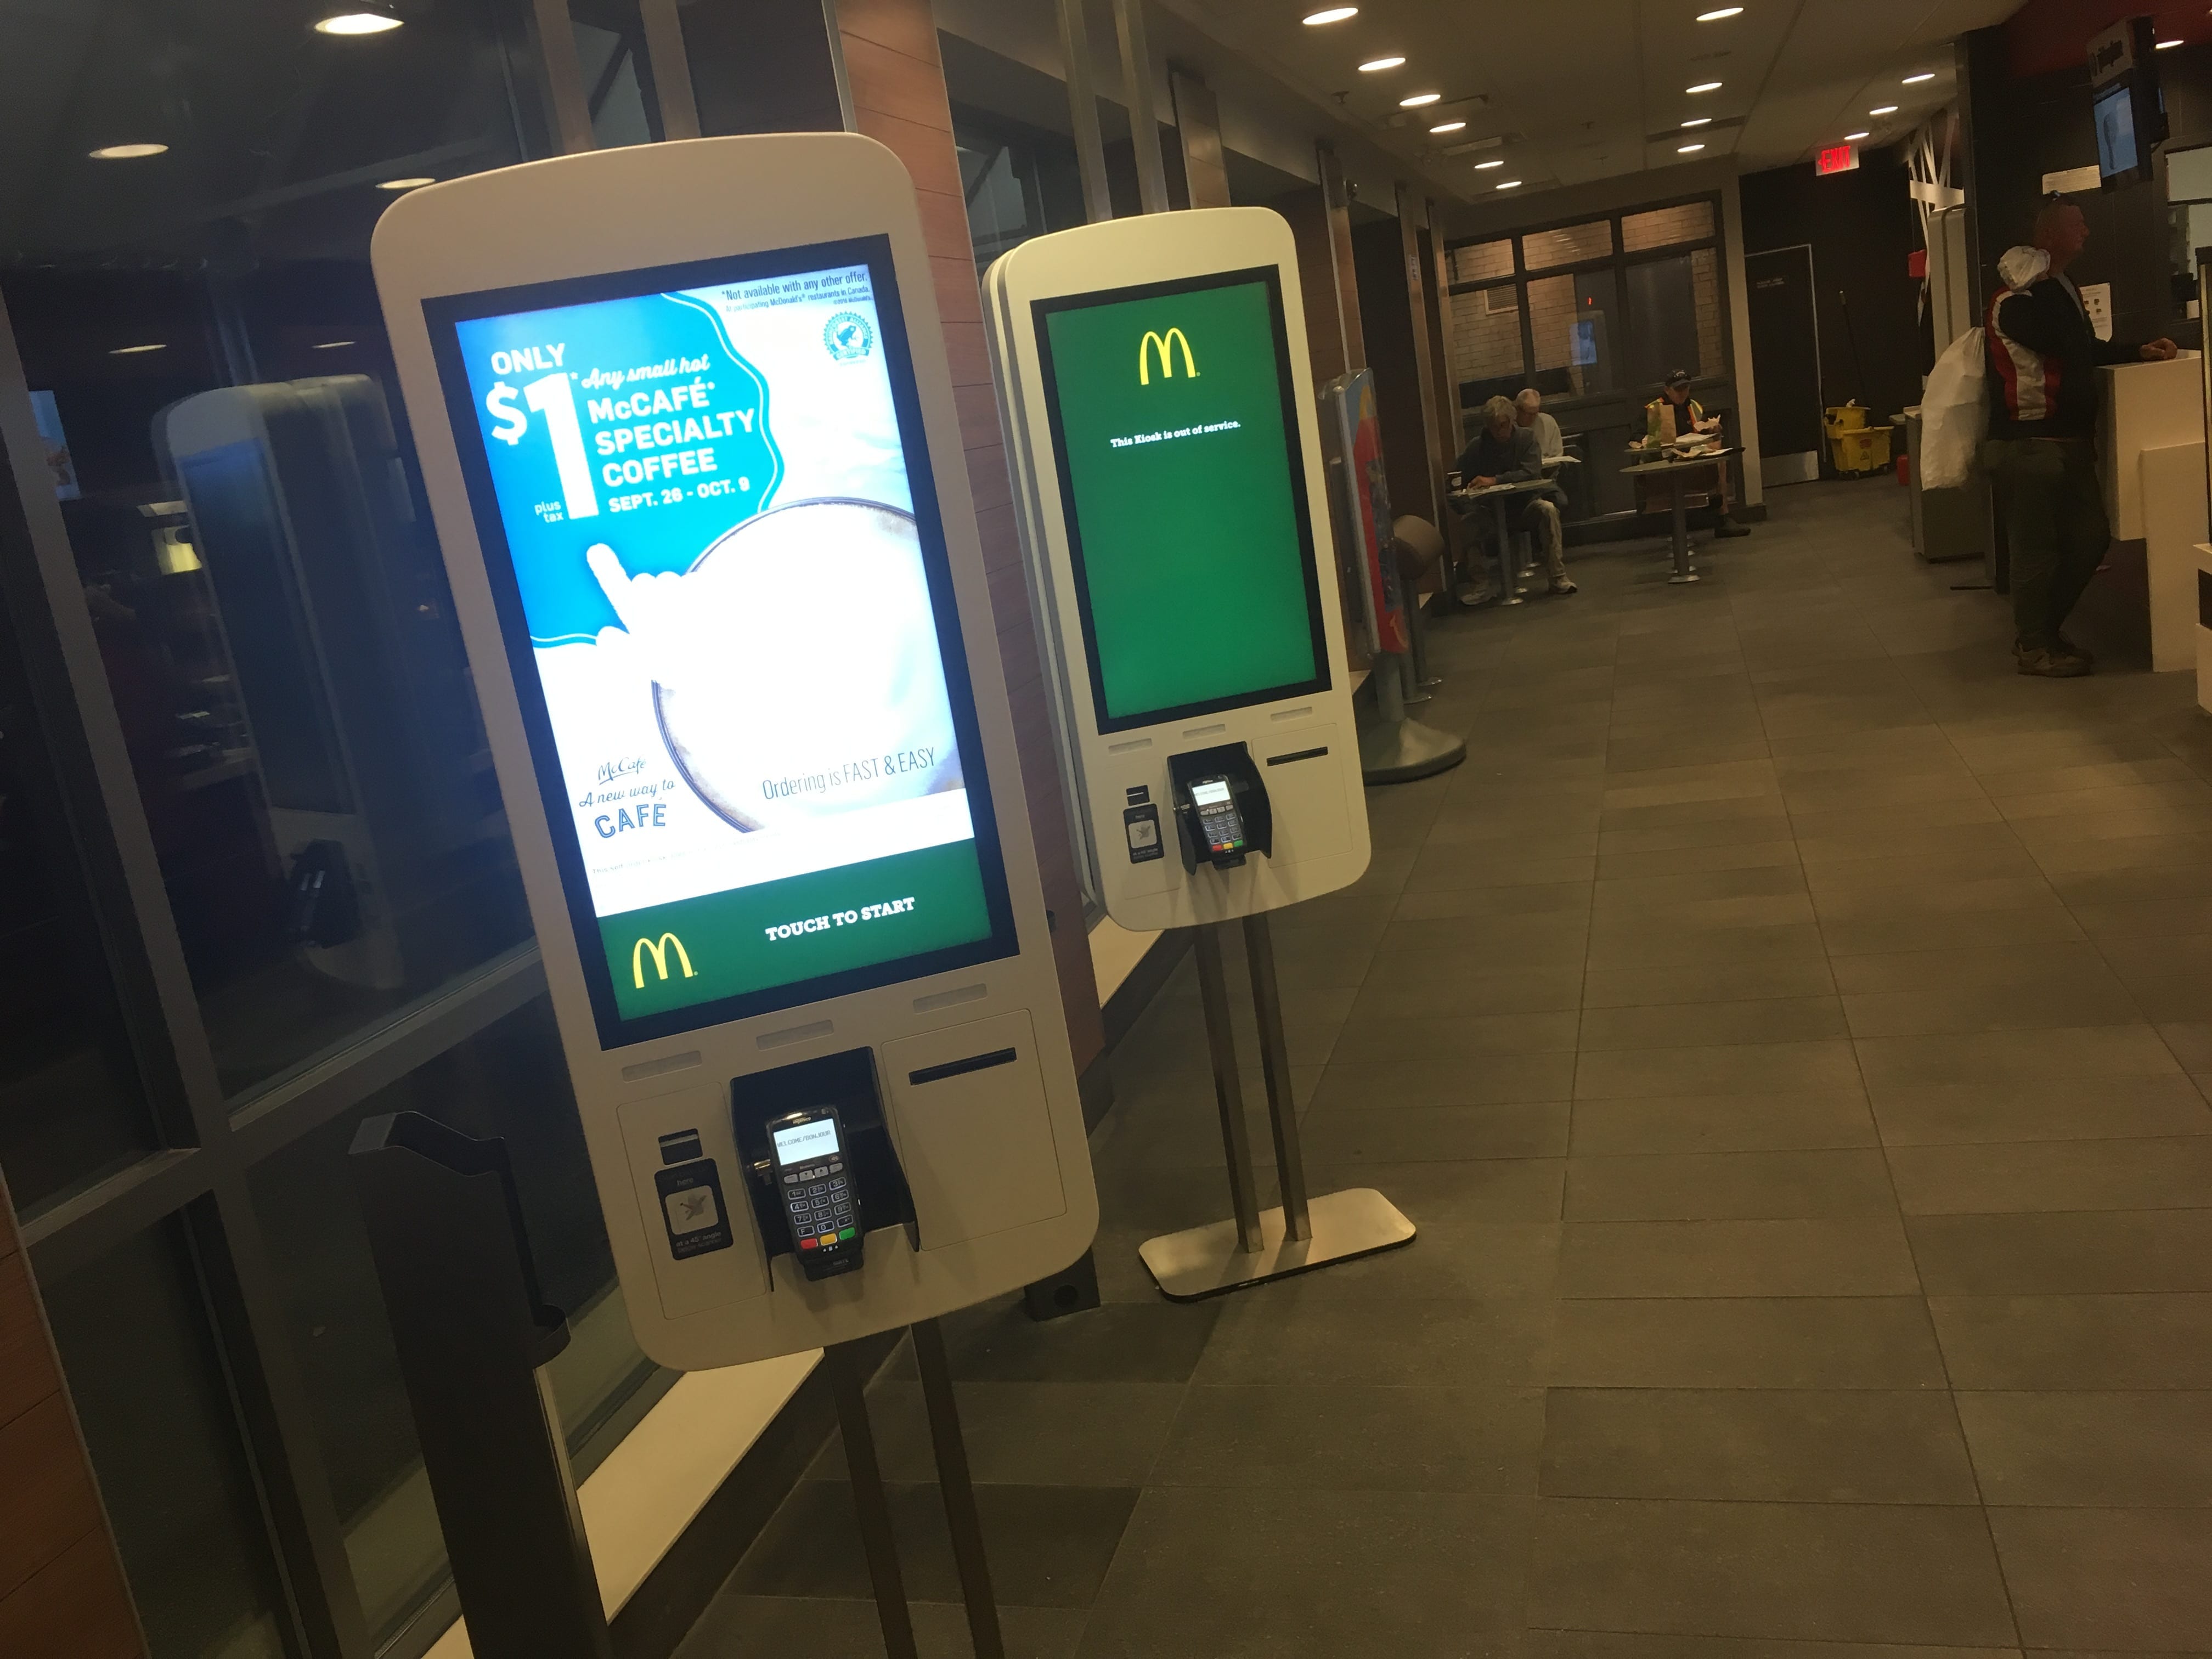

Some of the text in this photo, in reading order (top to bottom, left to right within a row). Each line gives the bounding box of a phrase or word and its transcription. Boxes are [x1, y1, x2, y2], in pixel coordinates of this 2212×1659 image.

[1821, 145, 1850, 173] EXIT
[744, 284, 780, 298] available
[782, 280, 802, 293] with
[804, 280, 819, 291] any
[821, 275, 843, 287] other
[845, 271, 868, 284] offer.
[808, 290, 840, 301] restaurants
[848, 285, 870, 295] Canada.
[491, 343, 565, 375] ONLY
[581, 353, 711, 391] Any small hot
[595, 408, 755, 456] SPECIALTY
[1110, 420, 1242, 448] This Kiosk is out of service.
[602, 447, 718, 488] COFFEE
[534, 500, 562, 516] plus
[608, 492, 659, 513] SEPT.
[697, 479, 736, 499] OCT.
[543, 511, 564, 523] tax
[762, 747, 935, 800] Ordering is FAST & EASY
[579, 779, 676, 808] A new way to
[765, 896, 916, 941] TOUCH TO START
[676, 1177, 694, 1186] here
